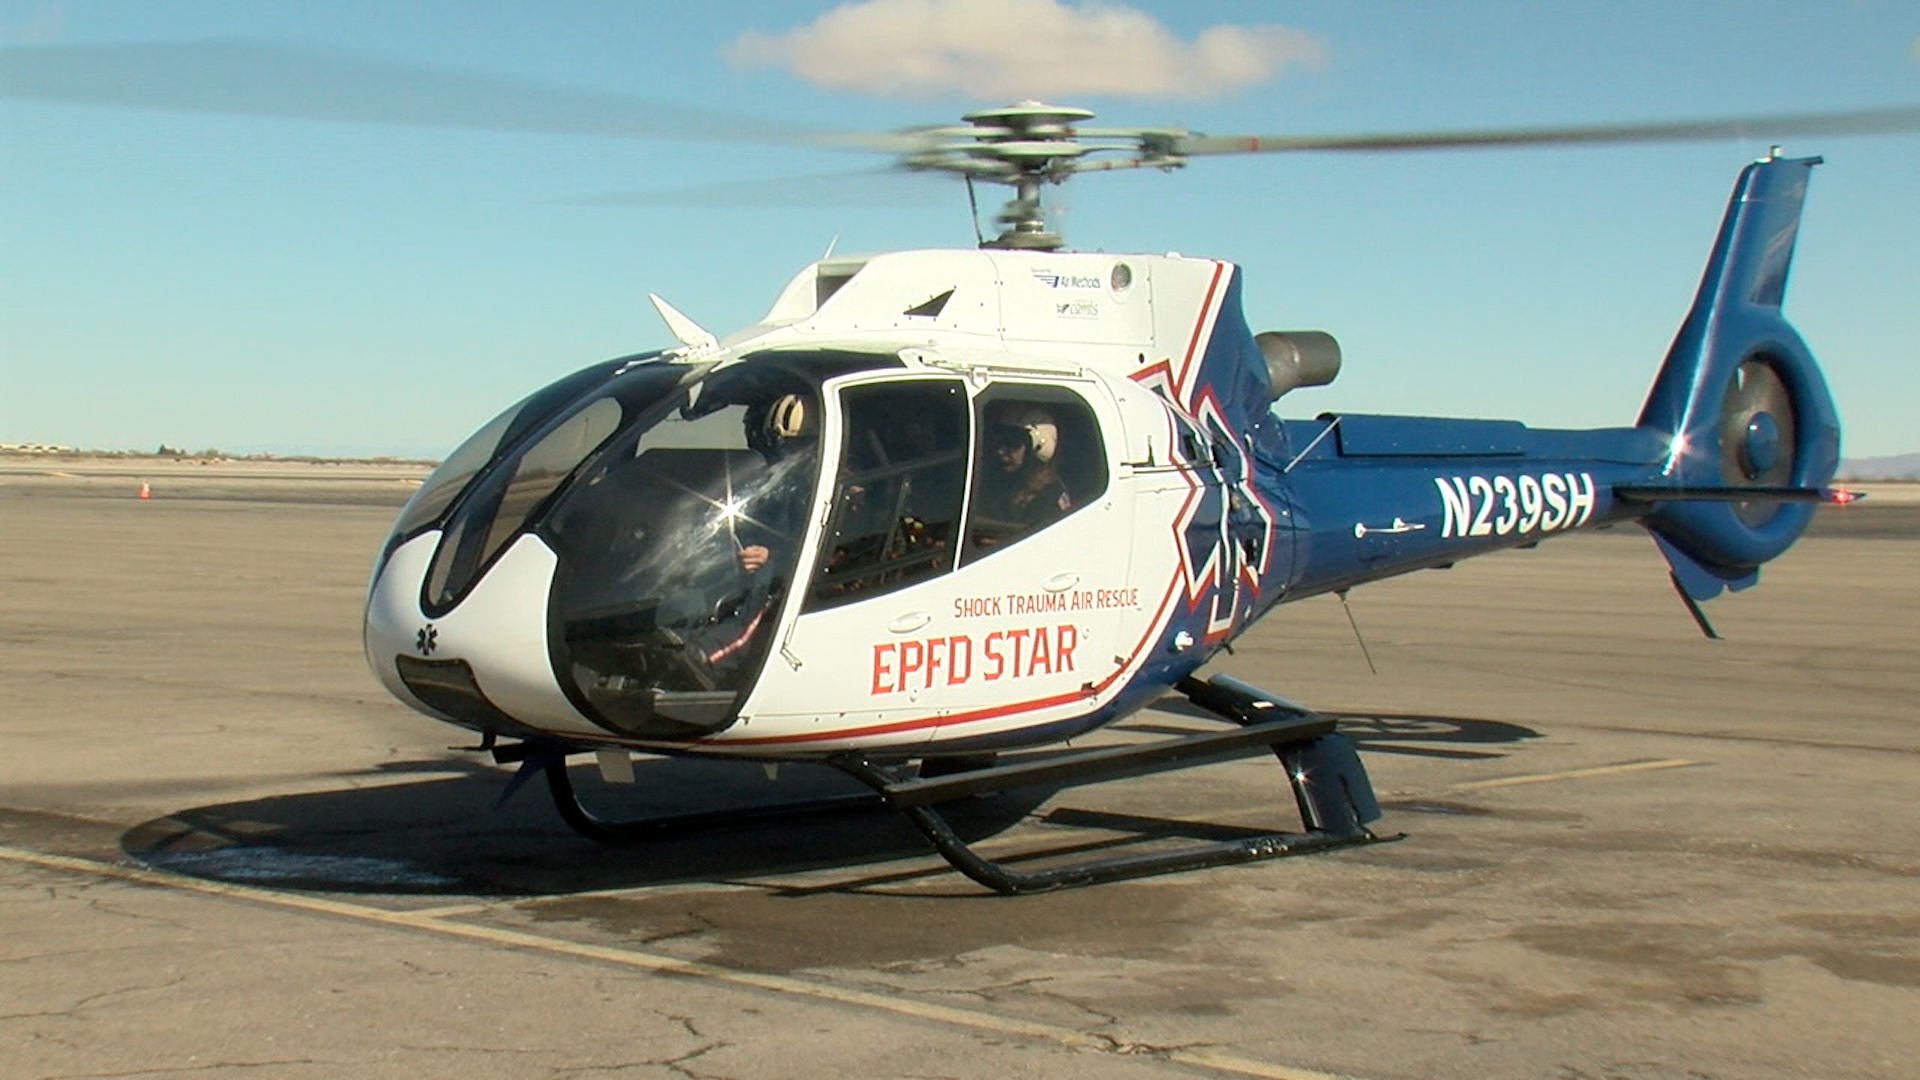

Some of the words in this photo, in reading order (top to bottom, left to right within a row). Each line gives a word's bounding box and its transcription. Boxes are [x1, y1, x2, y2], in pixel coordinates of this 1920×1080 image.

[1060, 275, 1070, 287] Air
[1434, 473, 1595, 538] N239SH
[954, 597, 1002, 618] SHOCK
[1007, 593, 1067, 616] TRAUMA
[1096, 588, 1139, 609] RESCUE
[871, 634, 973, 695] EPFD
[983, 624, 1078, 682] STAR
